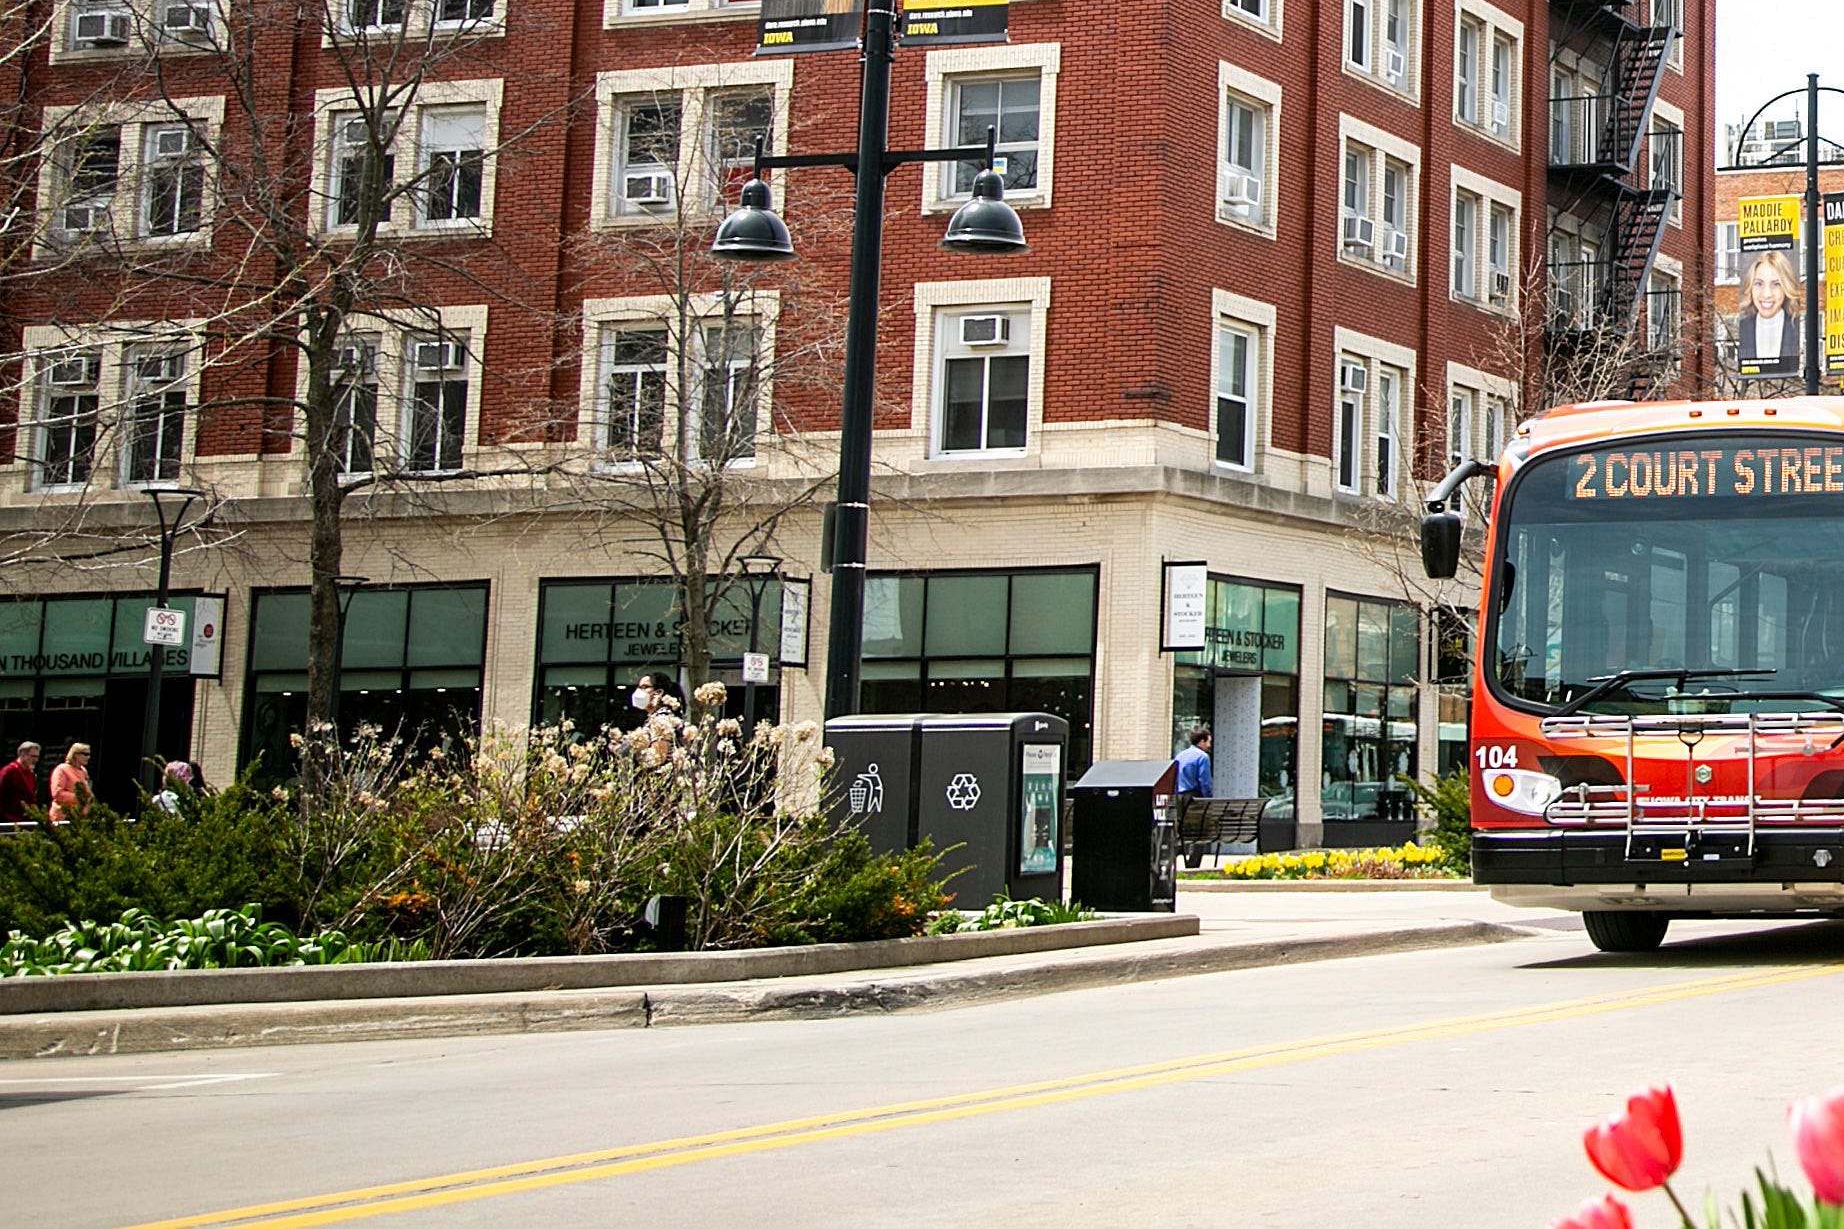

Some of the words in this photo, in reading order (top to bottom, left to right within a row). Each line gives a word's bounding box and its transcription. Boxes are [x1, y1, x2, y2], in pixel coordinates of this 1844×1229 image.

[907, 22, 938, 35] IOWA
[763, 31, 793, 44] IOWA
[1743, 202, 1782, 218] MADDIE
[1743, 218, 1793, 234] PALLARDY
[1575, 453, 1597, 498] 2
[1604, 450, 1723, 498] COURT
[565, 622, 650, 640] HERTEEN
[655, 621, 666, 638] &
[672, 619, 751, 638] SCKE
[1205, 626, 1234, 646] RTEEN
[1236, 631, 1242, 646] &
[1244, 631, 1285, 651] STOCKER
[624, 643, 688, 657] JEWELE
[1221, 650, 1257, 664] JEWELERS
[11, 653, 104, 671] THOUSAND
[109, 650, 188, 668] VILLAES
[1474, 745, 1518, 769] 104
[1713, 795, 1762, 804] TRANST
